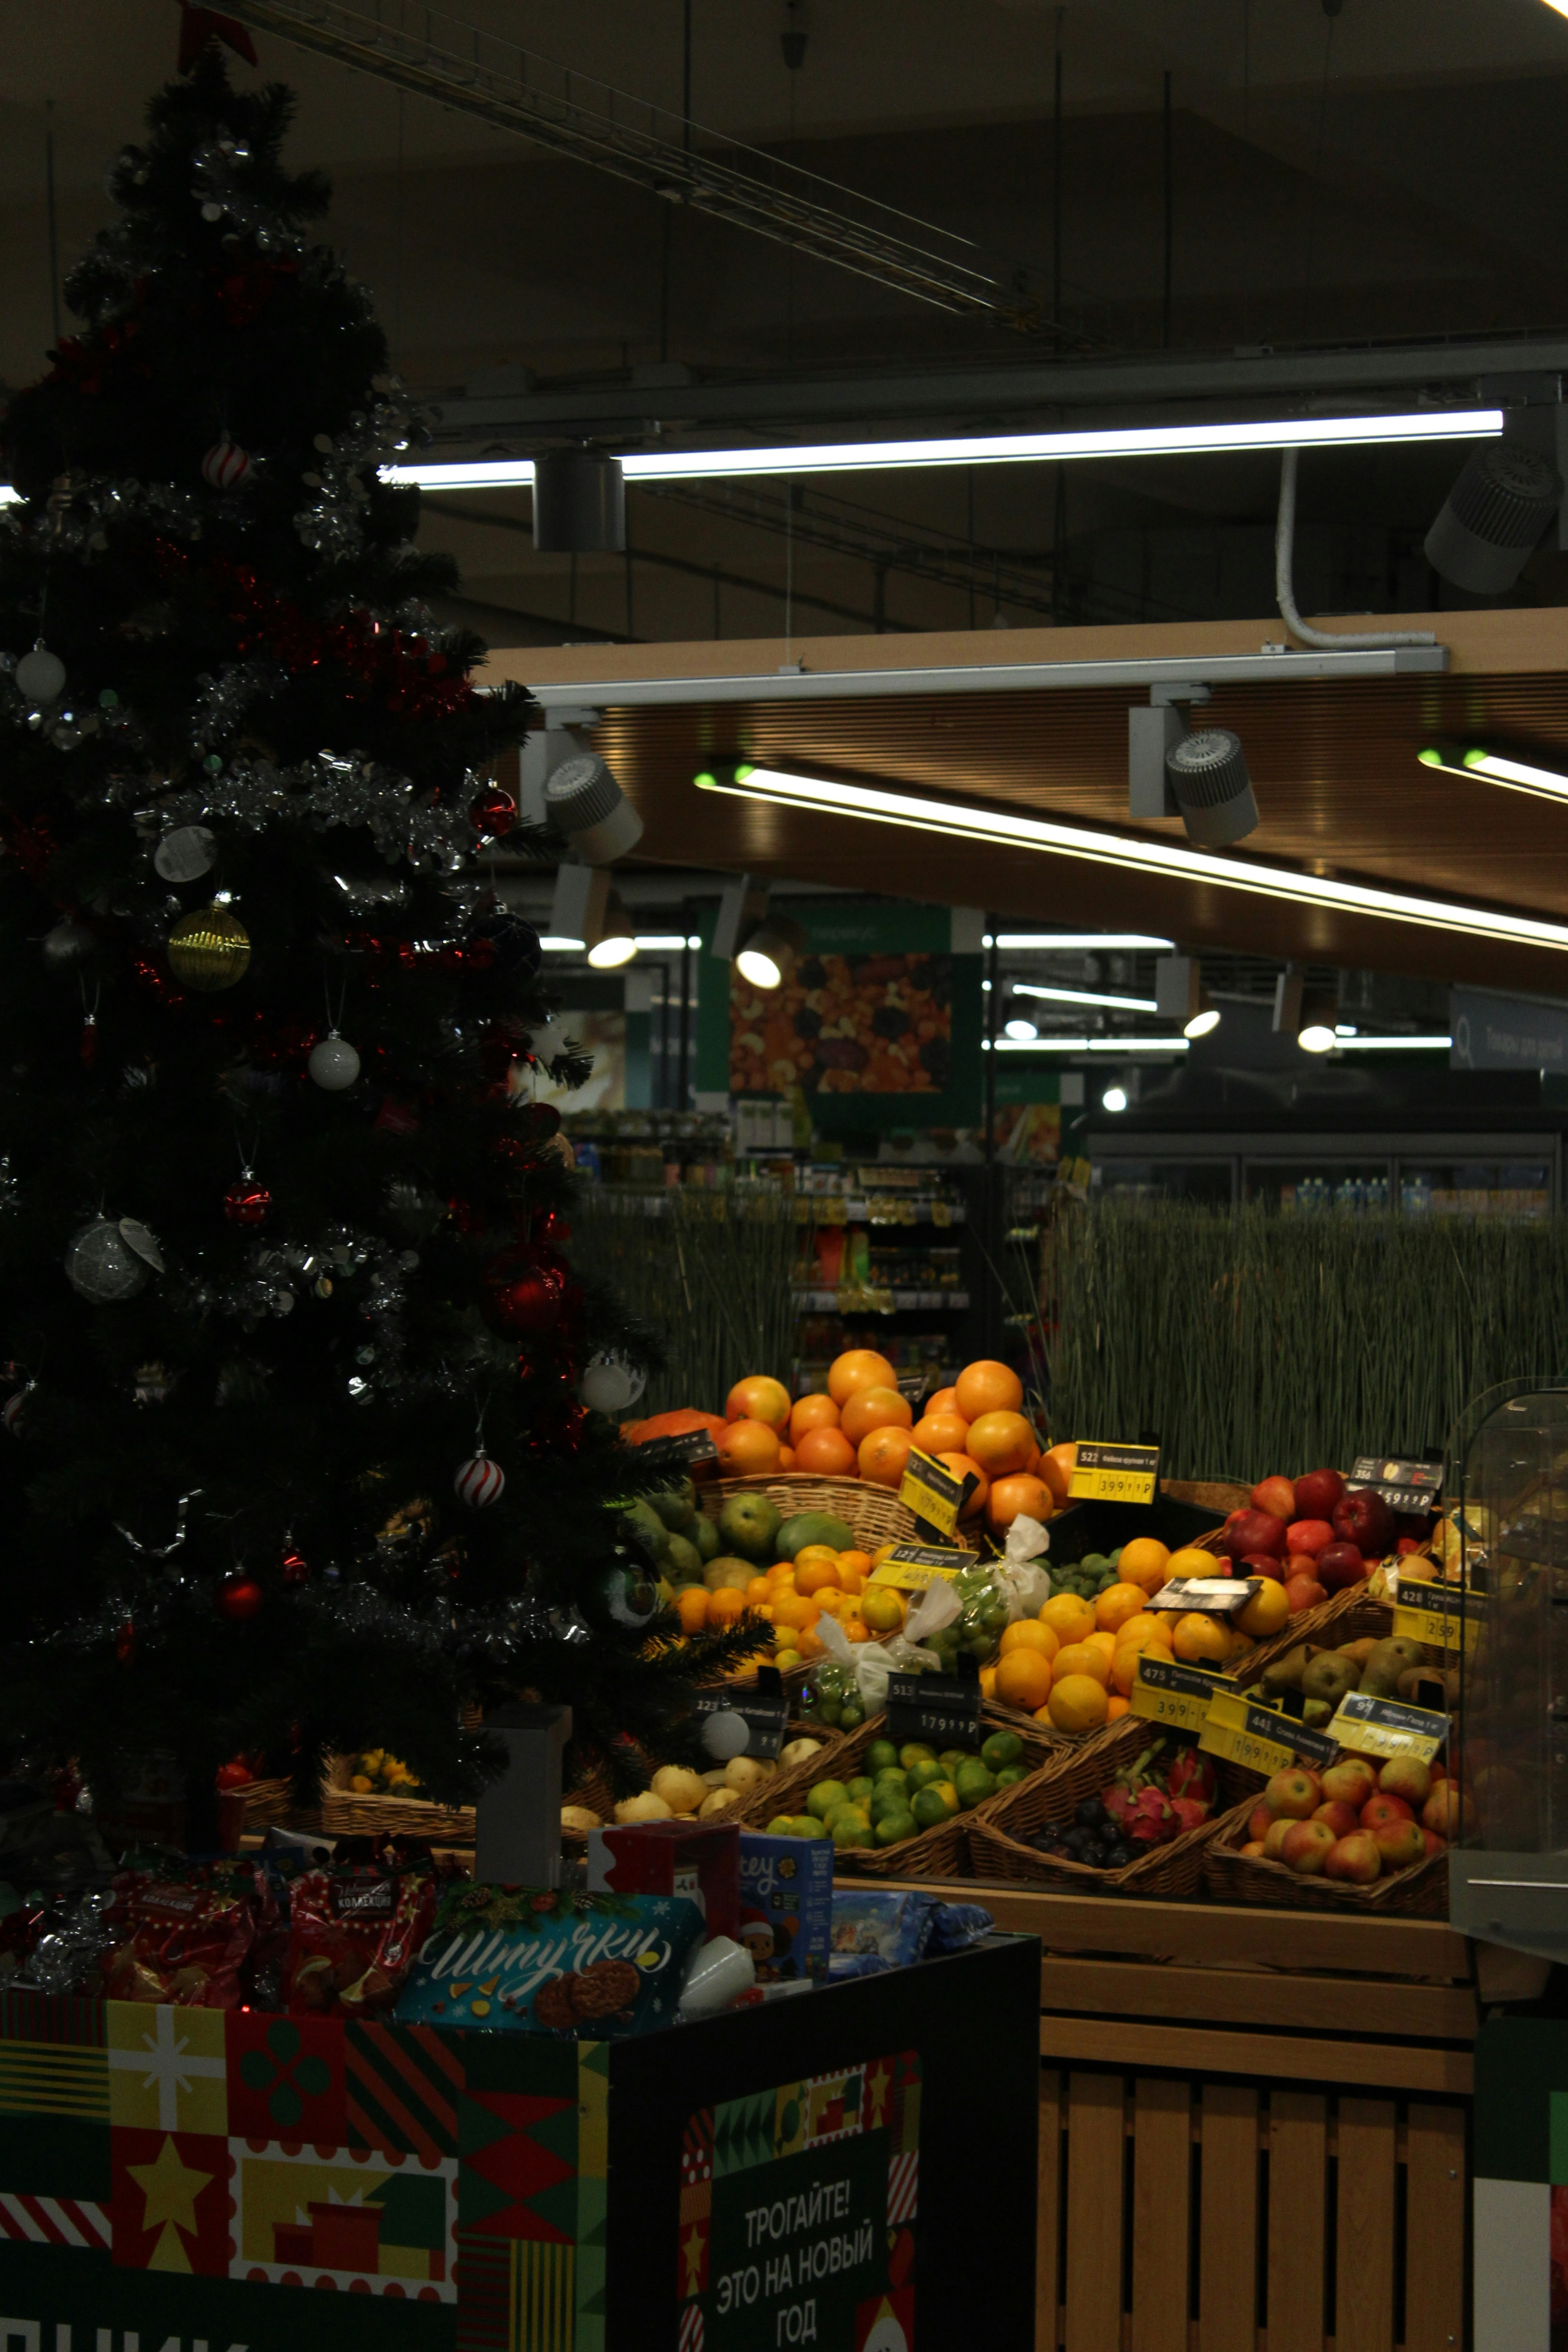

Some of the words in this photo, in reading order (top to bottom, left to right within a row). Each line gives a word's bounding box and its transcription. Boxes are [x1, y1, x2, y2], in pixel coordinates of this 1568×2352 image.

[1143, 1667, 1166, 1681] 475
[418, 1921, 672, 2002] Штучки
[745, 2179, 851, 2248] ТРОГАЙТЕ!
[716, 2265, 760, 2314] ЭТО
[764, 2253, 794, 2297] НА
[798, 2218, 874, 2285] НОВЫЙ
[776, 2298, 817, 2348] ГОД
